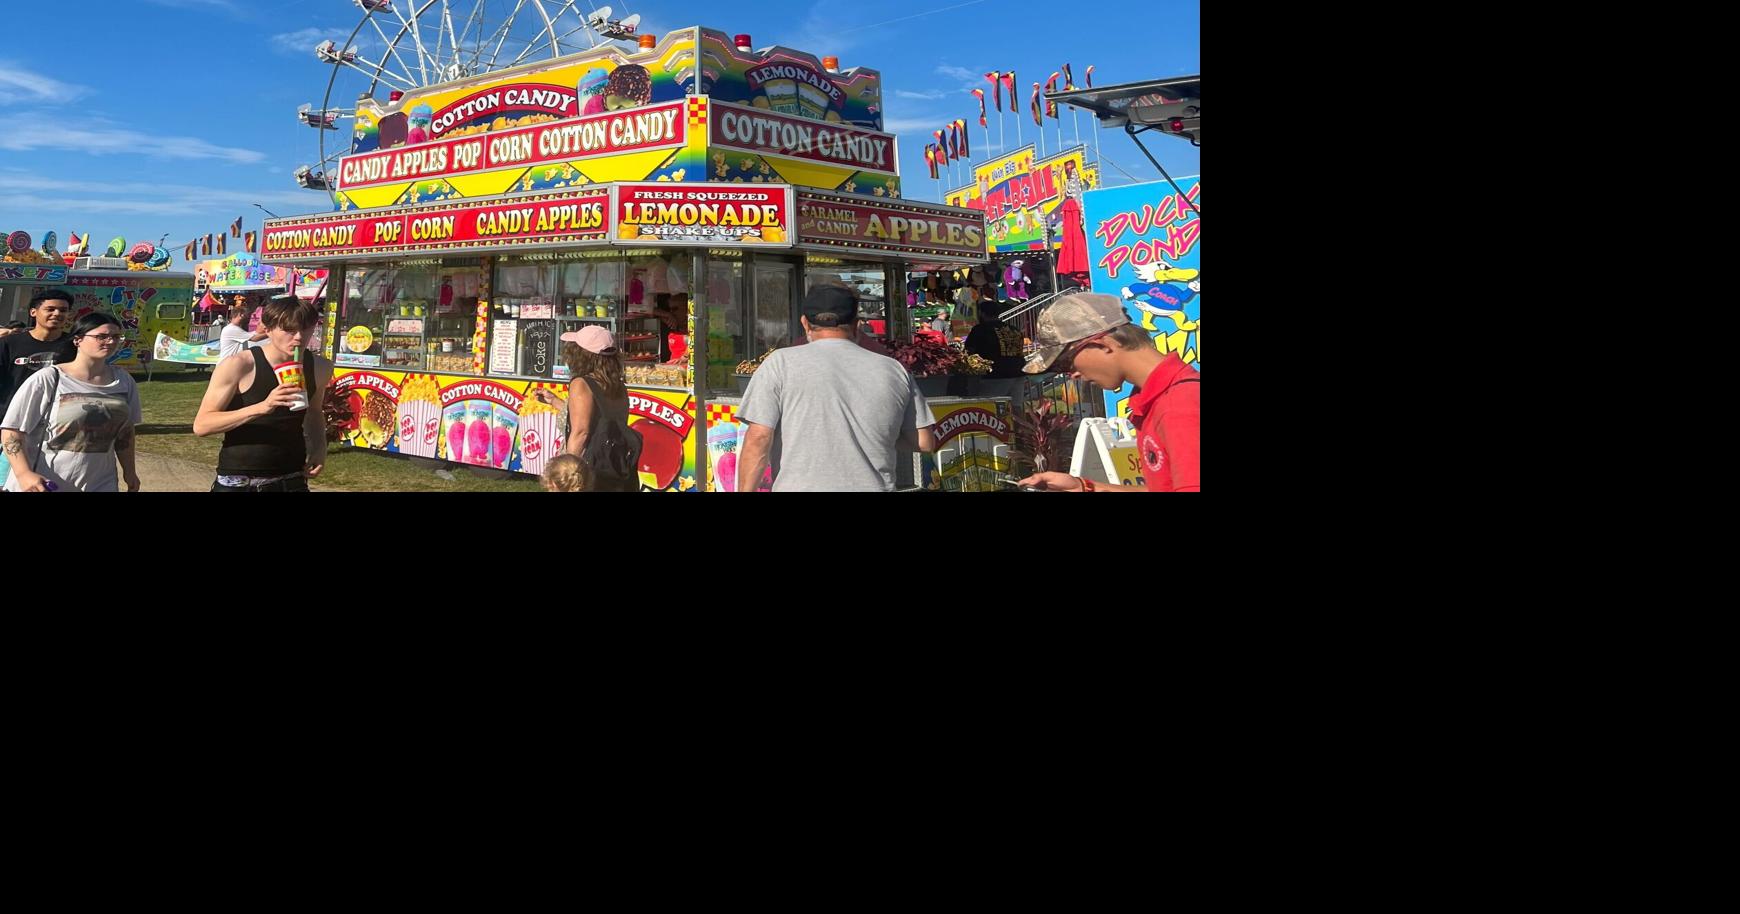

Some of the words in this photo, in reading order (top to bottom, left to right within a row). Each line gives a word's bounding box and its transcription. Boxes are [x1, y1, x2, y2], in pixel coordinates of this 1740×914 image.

[751, 65, 842, 100] LEMONADE
[431, 92, 500, 134] COTTON
[504, 89, 577, 112] CANDY
[343, 156, 392, 183] CANDY
[392, 147, 447, 178] APPLES
[453, 142, 481, 169] POP
[489, 132, 534, 163] CORN
[539, 120, 608, 156] COTTON
[610, 109, 679, 149] CANDY
[721, 112, 813, 152] COTTON
[817, 130, 887, 165] CANDY
[634, 191, 683, 200] FRESH
[687, 192, 769, 201] SQUEEZED
[266, 229, 311, 250] COTTON
[313, 225, 356, 247] CANDY
[374, 221, 402, 242] POP
[411, 216, 455, 240] CORN
[476, 208, 533, 236] CANDY
[535, 202, 603, 232] APPLES
[623, 202, 780, 226] LEMONADE
[801, 205, 857, 223] CARAMEL
[816, 220, 859, 236] CANDY
[1096, 182, 1199, 247] DUCK
[641, 226, 714, 236] SHAKE
[721, 227, 761, 237] UPS
[864, 213, 982, 247] APPLES
[1099, 218, 1199, 278] POND
[0, 266, 66, 280] KETS
[208, 269, 241, 283] WATER
[245, 270, 270, 281] RACE
[221, 259, 259, 269] BALLOON
[534, 341, 546, 373] Coke
[358, 374, 399, 398] APPLES
[442, 383, 482, 403] COTTON
[484, 384, 522, 410] CANDY
[629, 395, 685, 428] PPLES
[933, 411, 1006, 440] LEMONADE
[1127, 453, 1143, 473] Sp
